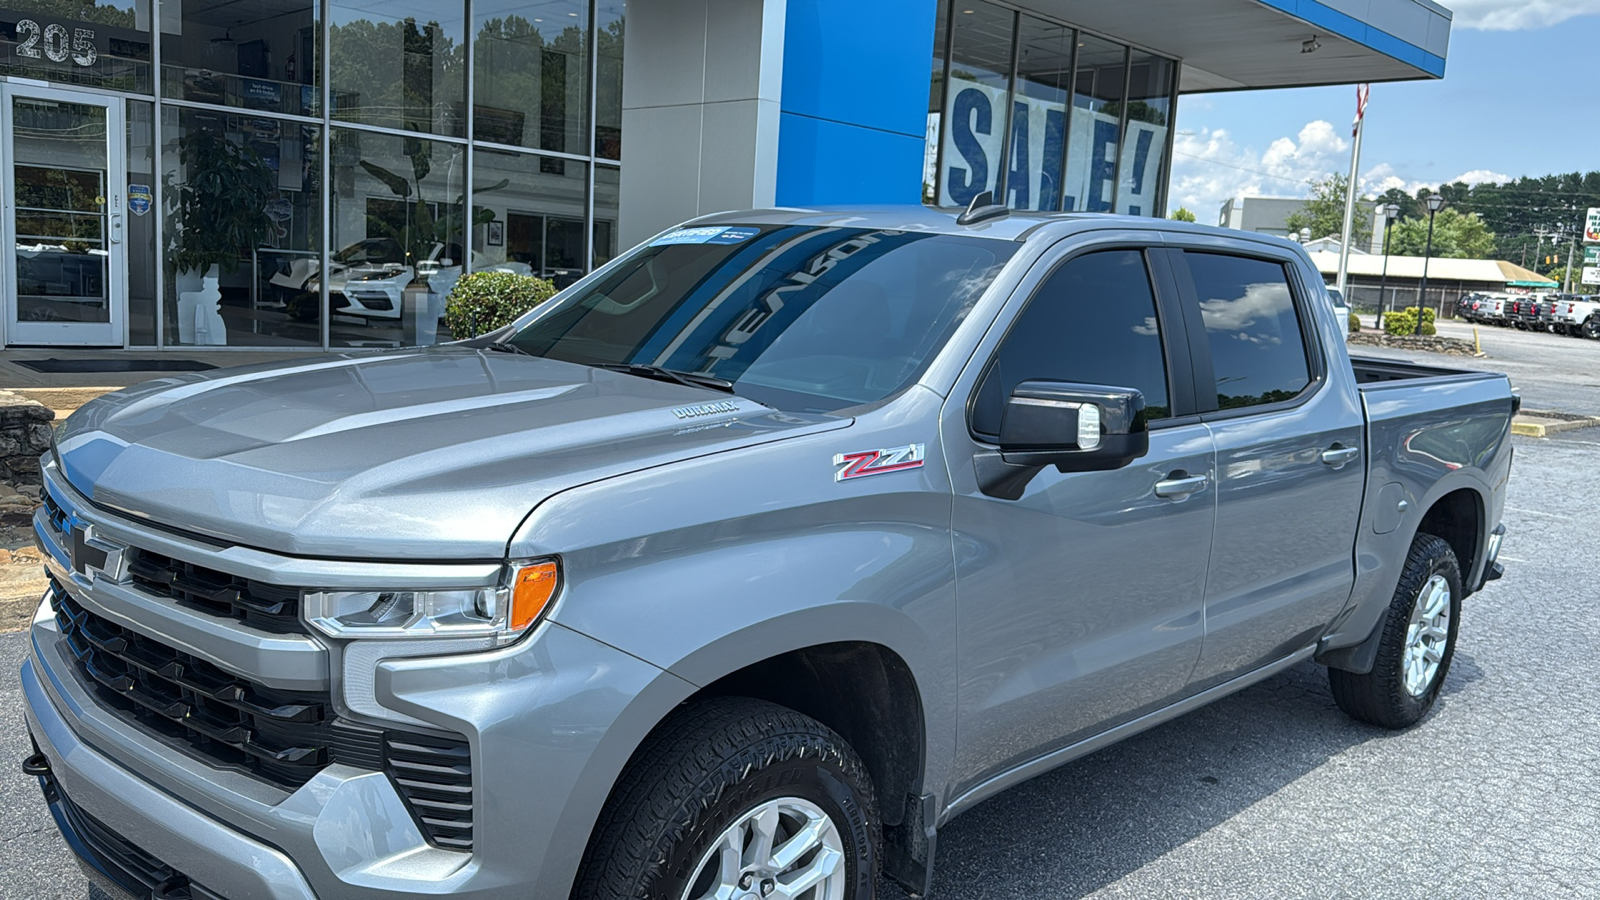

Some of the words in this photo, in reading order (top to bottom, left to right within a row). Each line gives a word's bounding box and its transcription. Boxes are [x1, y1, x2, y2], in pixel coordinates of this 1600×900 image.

[15, 19, 98, 67] 205
[948, 88, 1154, 215] SALE!
[671, 400, 740, 419] DURAMAX
[832, 443, 925, 482] Z71
